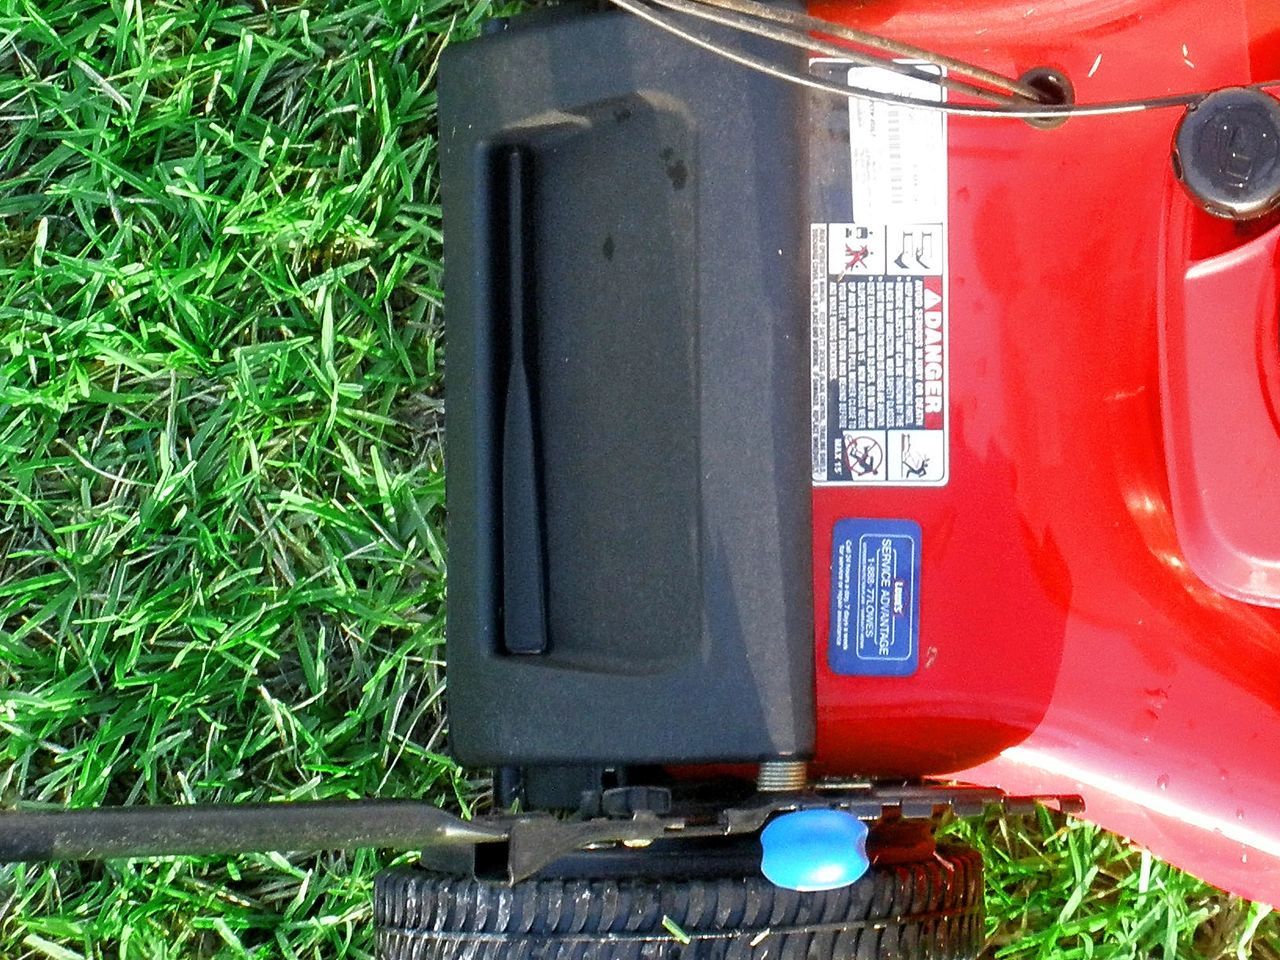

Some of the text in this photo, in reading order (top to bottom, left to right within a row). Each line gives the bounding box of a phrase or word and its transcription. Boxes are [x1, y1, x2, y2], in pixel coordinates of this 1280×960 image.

[924, 311, 941, 414] DANGER
[915, 382, 923, 396] OR
[915, 397, 923, 426] DEATH
[834, 439, 842, 458] MAX
[879, 539, 891, 655] SERVICE ADVANTAGE
